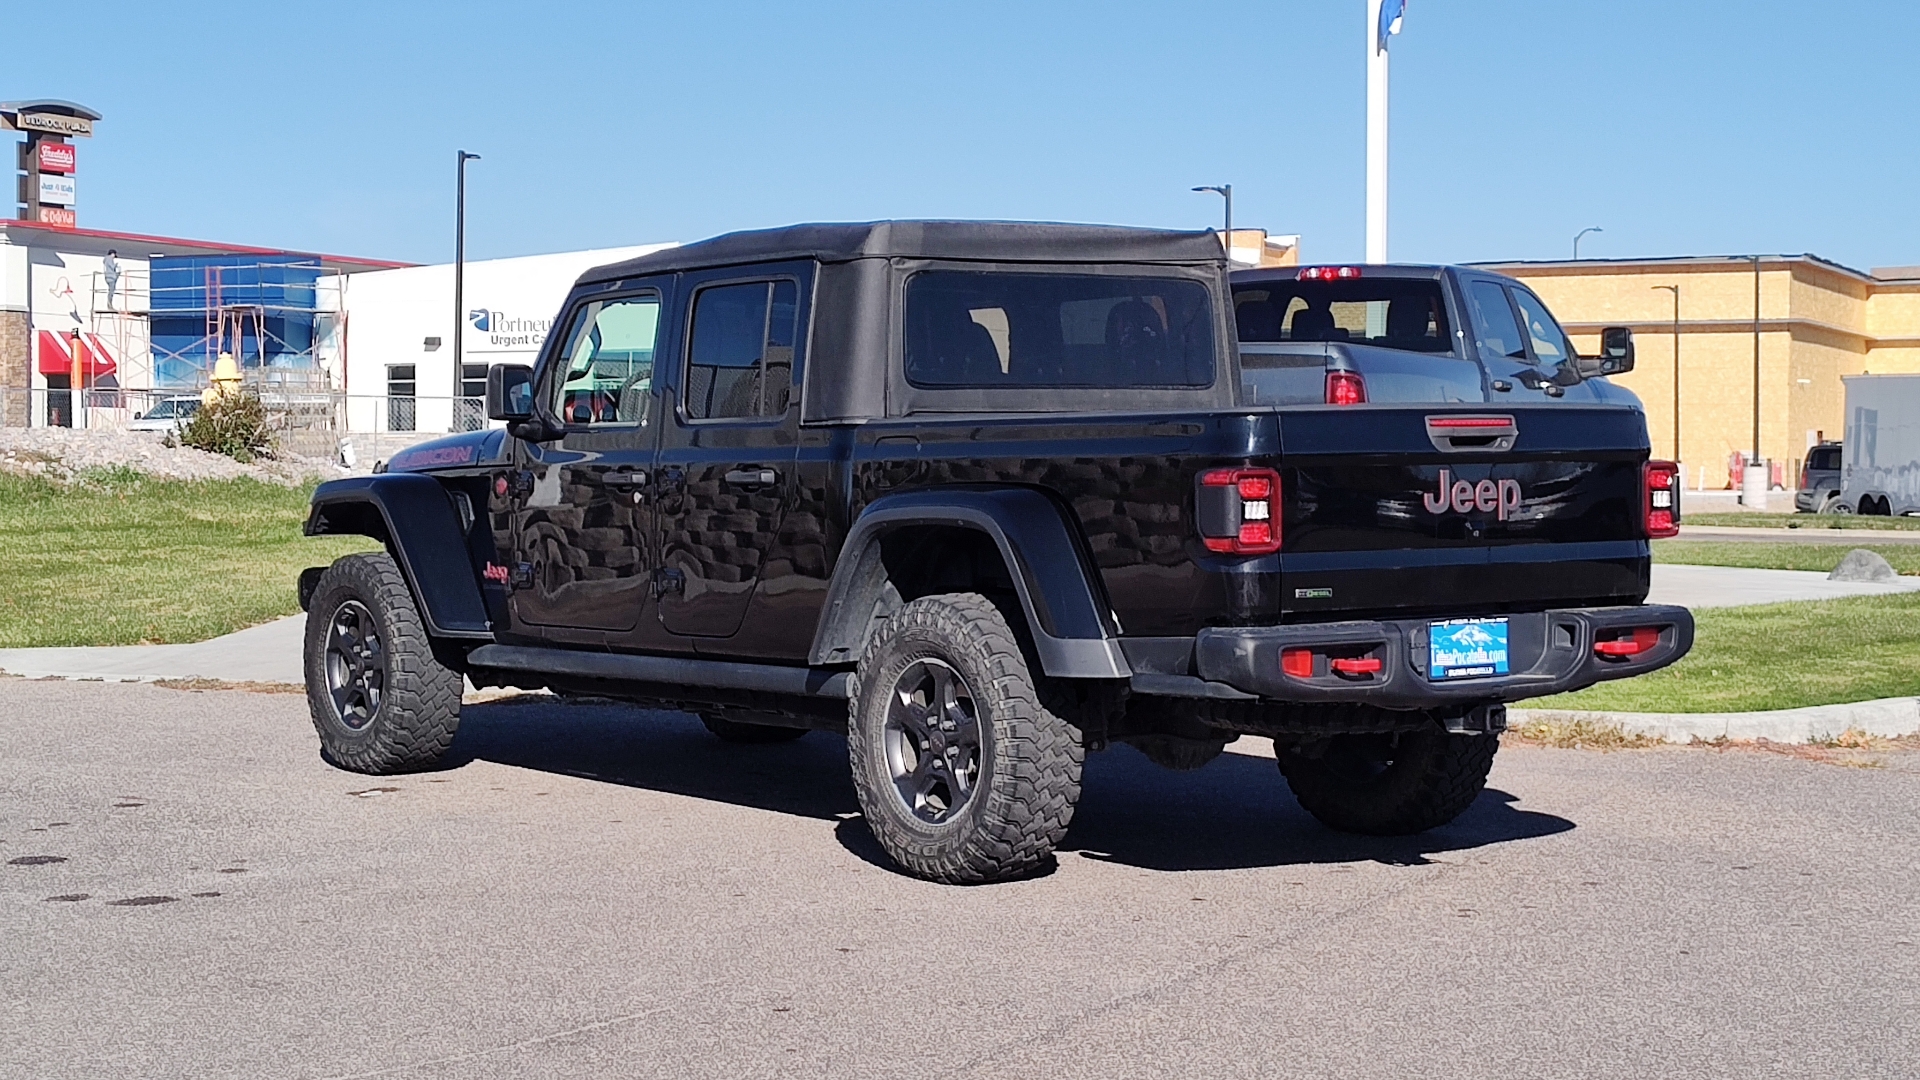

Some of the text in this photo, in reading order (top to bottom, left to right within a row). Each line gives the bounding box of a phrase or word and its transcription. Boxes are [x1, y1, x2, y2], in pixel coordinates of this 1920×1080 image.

[25, 115, 91, 133] BEDROCK PLAZA
[40, 145, 74, 164] Freddy's
[491, 334, 547, 347] Urgent Ca
[1424, 469, 1522, 521] Jeep
[483, 561, 508, 585] Jeep
